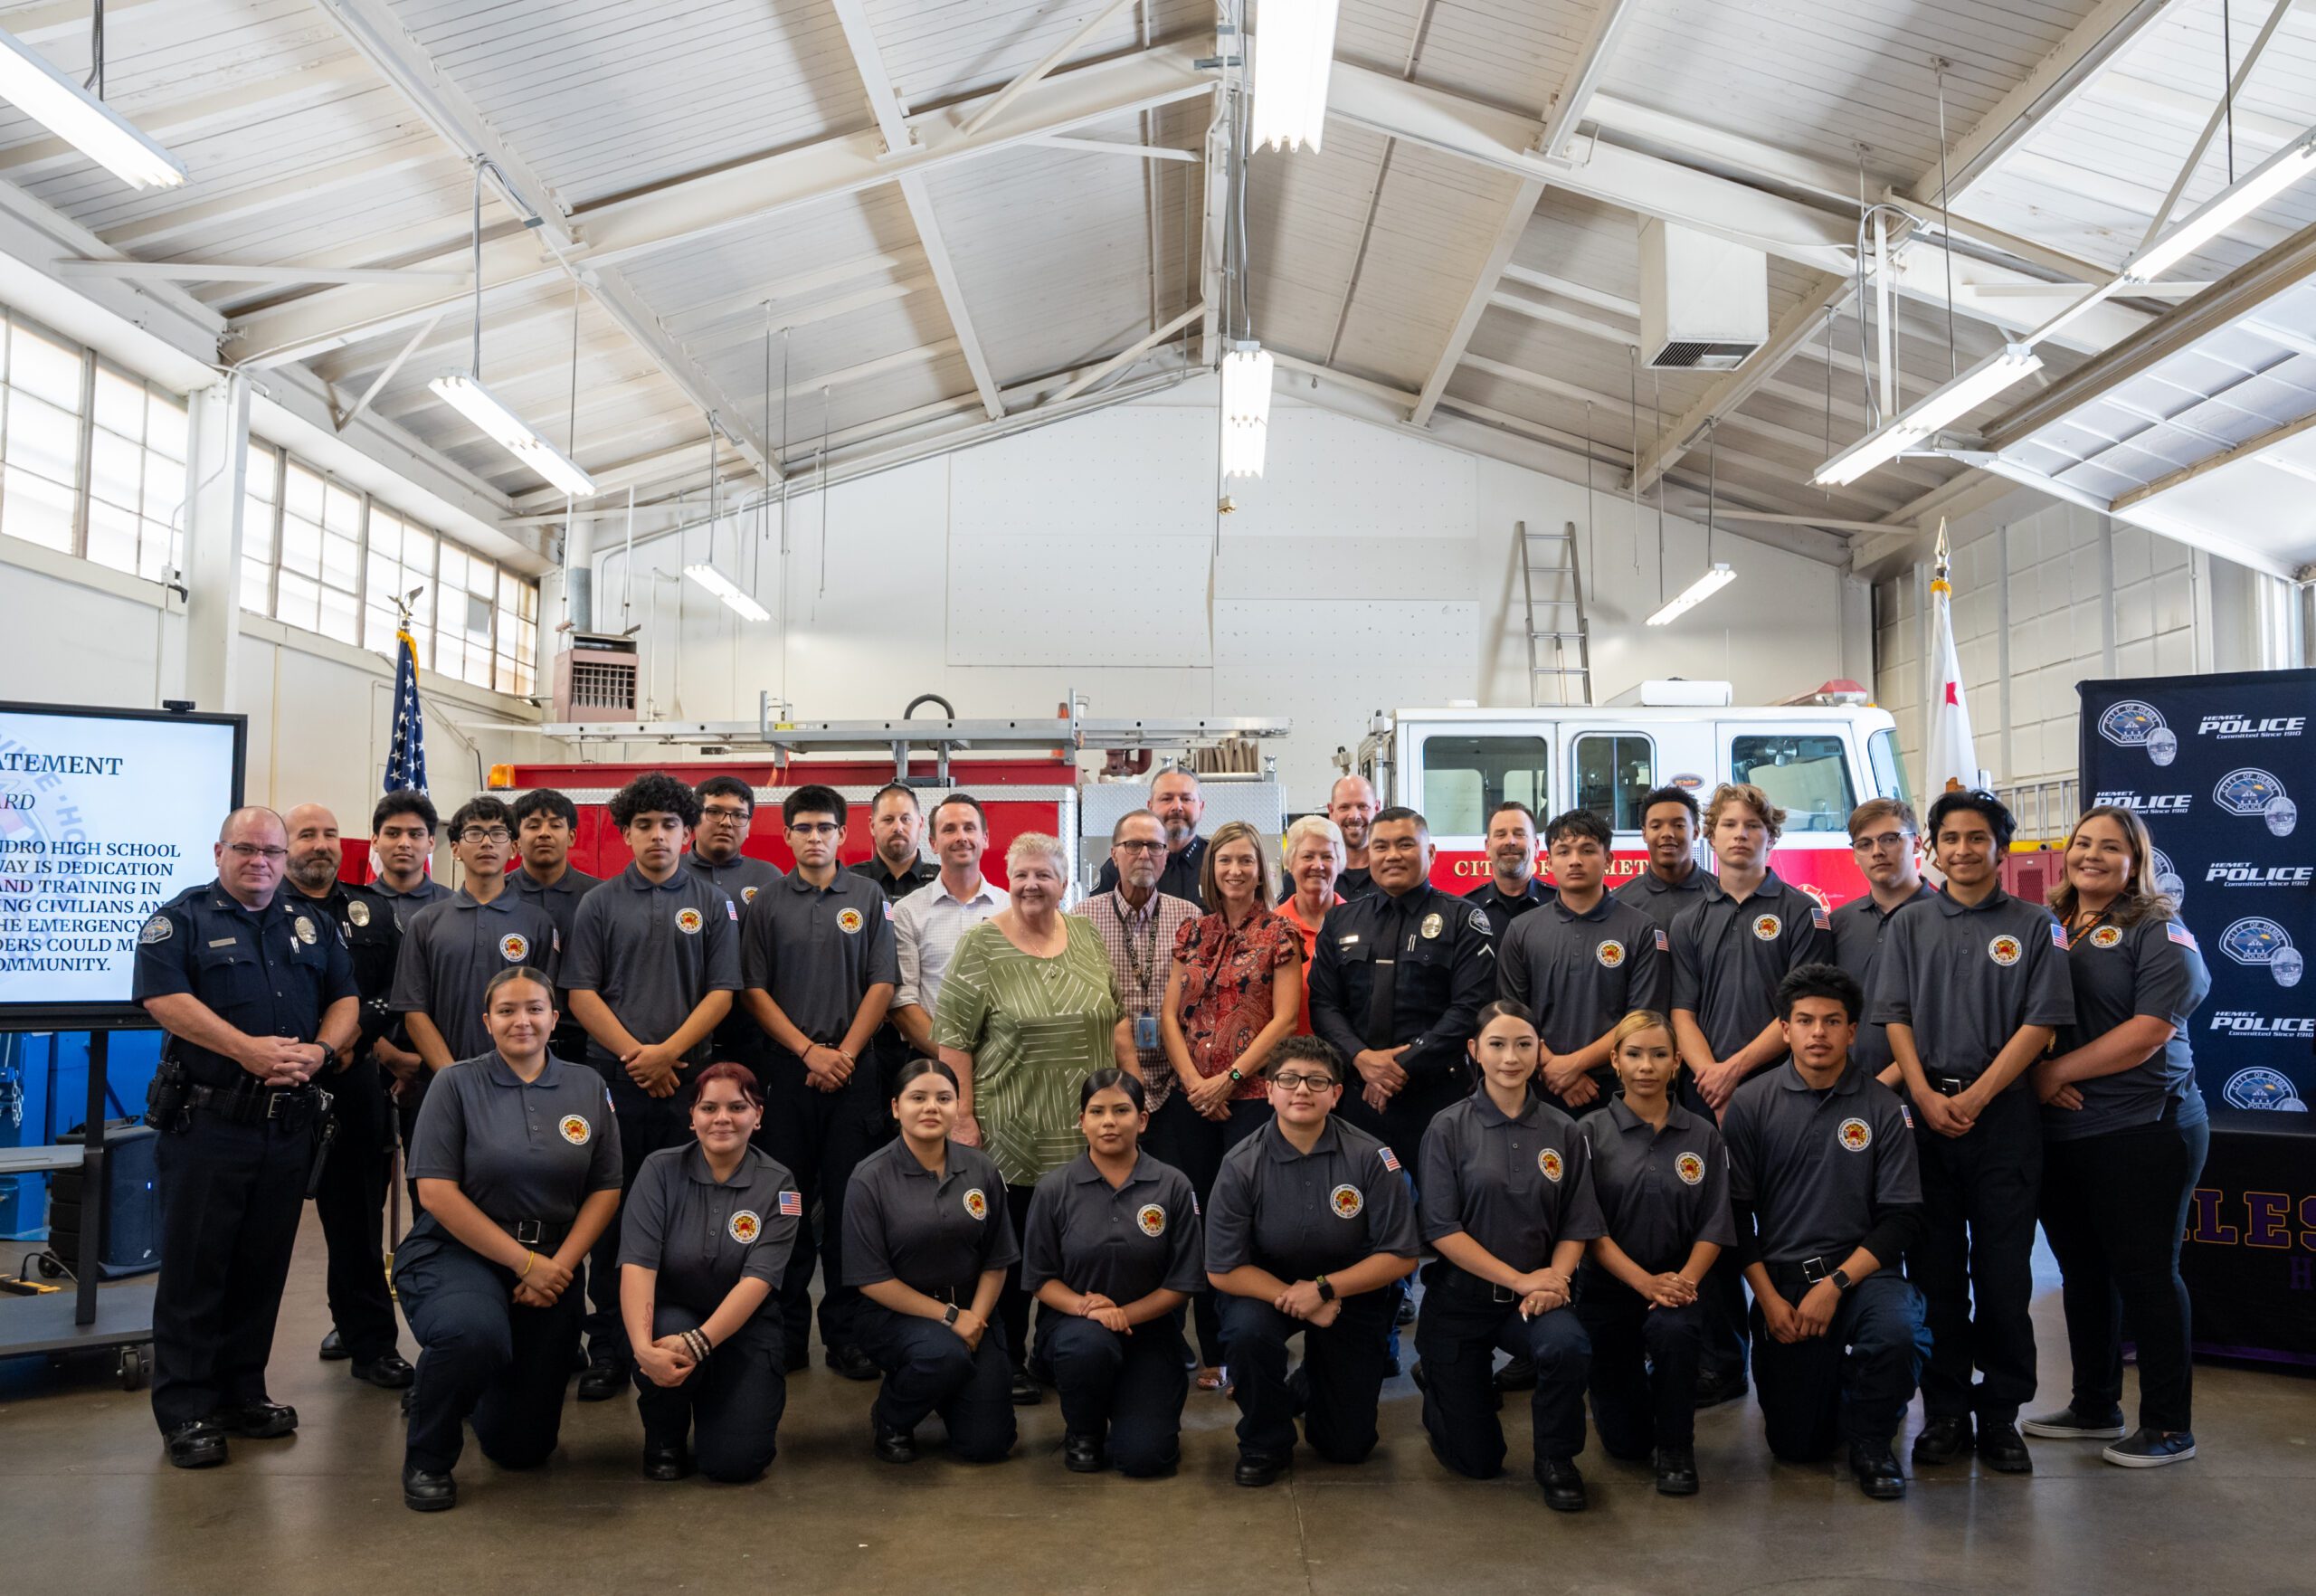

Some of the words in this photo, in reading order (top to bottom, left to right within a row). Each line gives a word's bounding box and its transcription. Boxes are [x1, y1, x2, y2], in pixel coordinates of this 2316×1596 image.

[2197, 717, 2307, 735] POLICE
[2221, 776, 2237, 793] CITY
[0, 793, 35, 810] RD
[2092, 794, 2193, 809] POLICE
[0, 840, 46, 854] DRO
[51, 841, 101, 856] HIGH
[106, 842, 181, 858] SCHOOL
[0, 860, 29, 874] AY
[34, 860, 52, 874] IS
[57, 860, 174, 876] DEDICATION
[1454, 860, 1493, 877] CIT
[1603, 860, 1649, 877] MET
[2205, 867, 2314, 881] POLICE
[0, 879, 33, 893] ND
[39, 879, 136, 894] TRAINING
[140, 881, 162, 895] IN
[0, 898, 32, 913] NG
[36, 899, 134, 914] CIVILIANS
[138, 900, 166, 913] AN
[27, 918, 147, 933] EMERGENCY
[2227, 925, 2245, 941] CITY
[0, 938, 42, 952] ERS
[46, 938, 111, 952] COULD
[116, 938, 135, 952] M
[2209, 1017, 2316, 1031] POLICE
